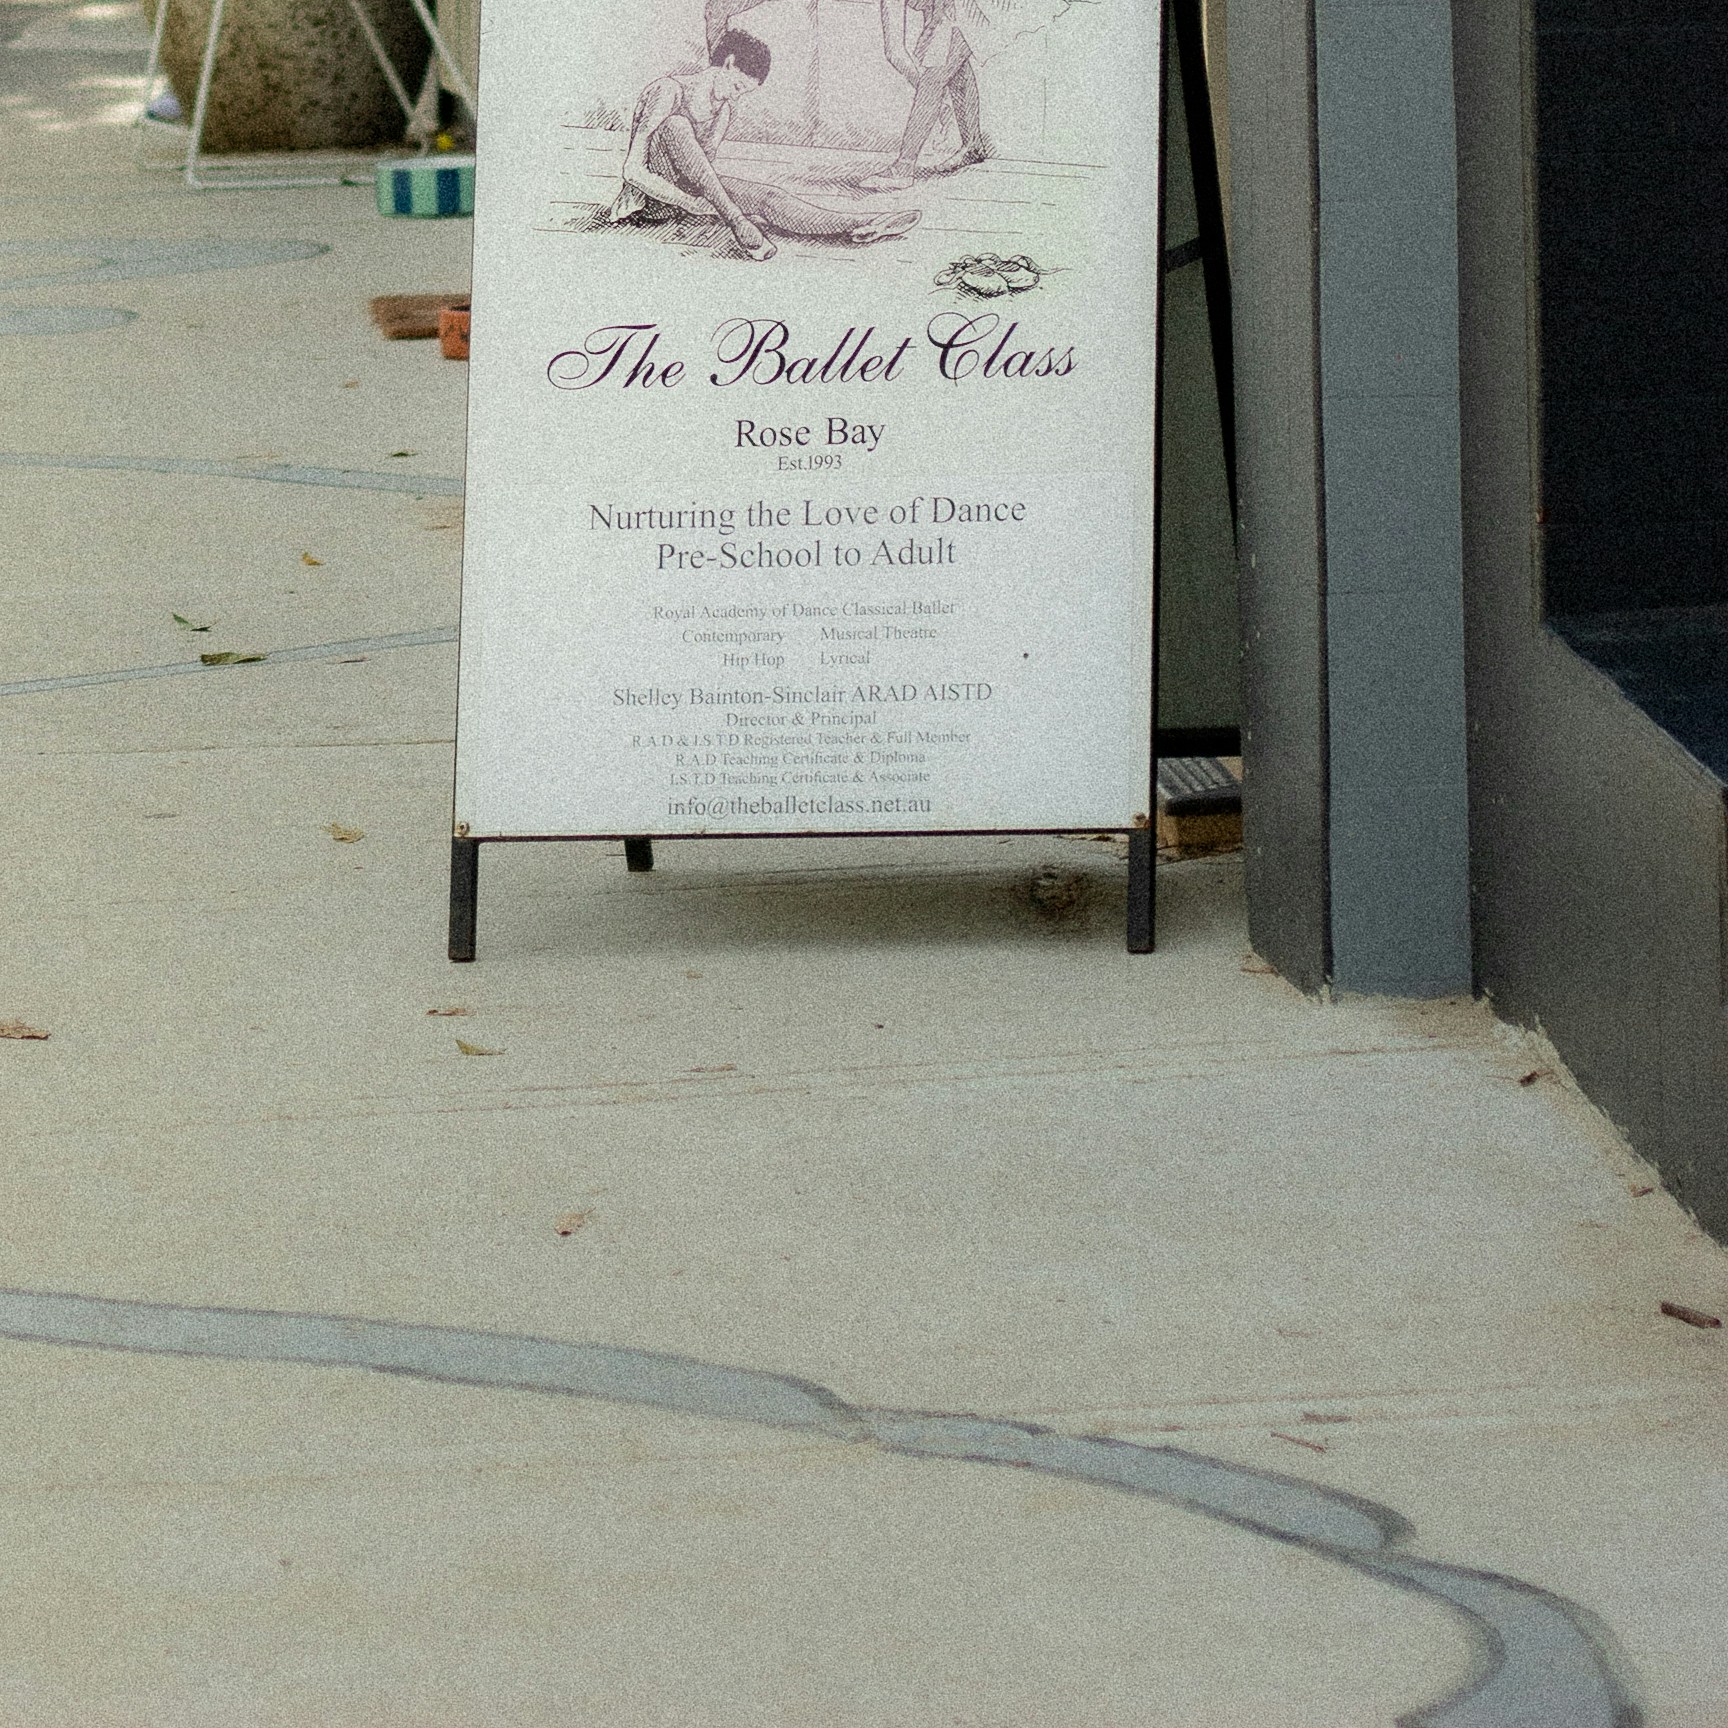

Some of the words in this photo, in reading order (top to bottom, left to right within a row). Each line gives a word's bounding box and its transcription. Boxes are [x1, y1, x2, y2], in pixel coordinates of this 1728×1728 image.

[547, 323, 686, 390] The
[710, 317, 917, 386] Ballet
[926, 311, 1078, 386] Class
[734, 418, 811, 448] Rose
[825, 416, 885, 451] Bay
[777, 454, 843, 472] Est.1993
[590, 501, 736, 535] Nurturing
[747, 501, 791, 527] the
[802, 499, 879, 526] Love
[889, 496, 925, 525] of
[932, 496, 1028, 524] Dance
[657, 540, 822, 570] Pre-School
[834, 543, 861, 566] to
[870, 538, 957, 566] Adult
[653, 605, 695, 622] Royal
[699, 604, 767, 621] Academy
[772, 603, 789, 618] of
[792, 603, 838, 617] Dance
[842, 601, 907, 616] Classical
[911, 600, 957, 615] Ballet
[682, 628, 785, 645] Contemporary
[820, 625, 878, 640] Musical
[884, 624, 938, 639] Theatre
[722, 652, 750, 668] Hip
[754, 651, 785, 668] Hop
[819, 650, 871, 667] Lyrical
[613, 688, 682, 710] Shelley
[690, 686, 847, 706] Bainton-Sinclair
[851, 684, 917, 703] ARAD
[923, 683, 993, 702] AISTD
[725, 712, 786, 727] Director
[791, 712, 805, 727] &
[810, 711, 877, 728] Principal
[676, 734, 689, 747] &
[744, 732, 812, 748] Registered
[816, 732, 867, 745] Teacher
[870, 732, 884, 745] &
[886, 730, 912, 744] Full
[916, 729, 972, 744] Member
[722, 753, 779, 769] Teaching
[782, 752, 849, 766] Certificate
[853, 752, 866, 766] &
[869, 751, 926, 766] Diploma
[719, 772, 779, 788] Teaching
[781, 771, 849, 785] Certificate
[852, 771, 865, 784] &
[668, 796, 931, 820] info@theballetclass.net.au
